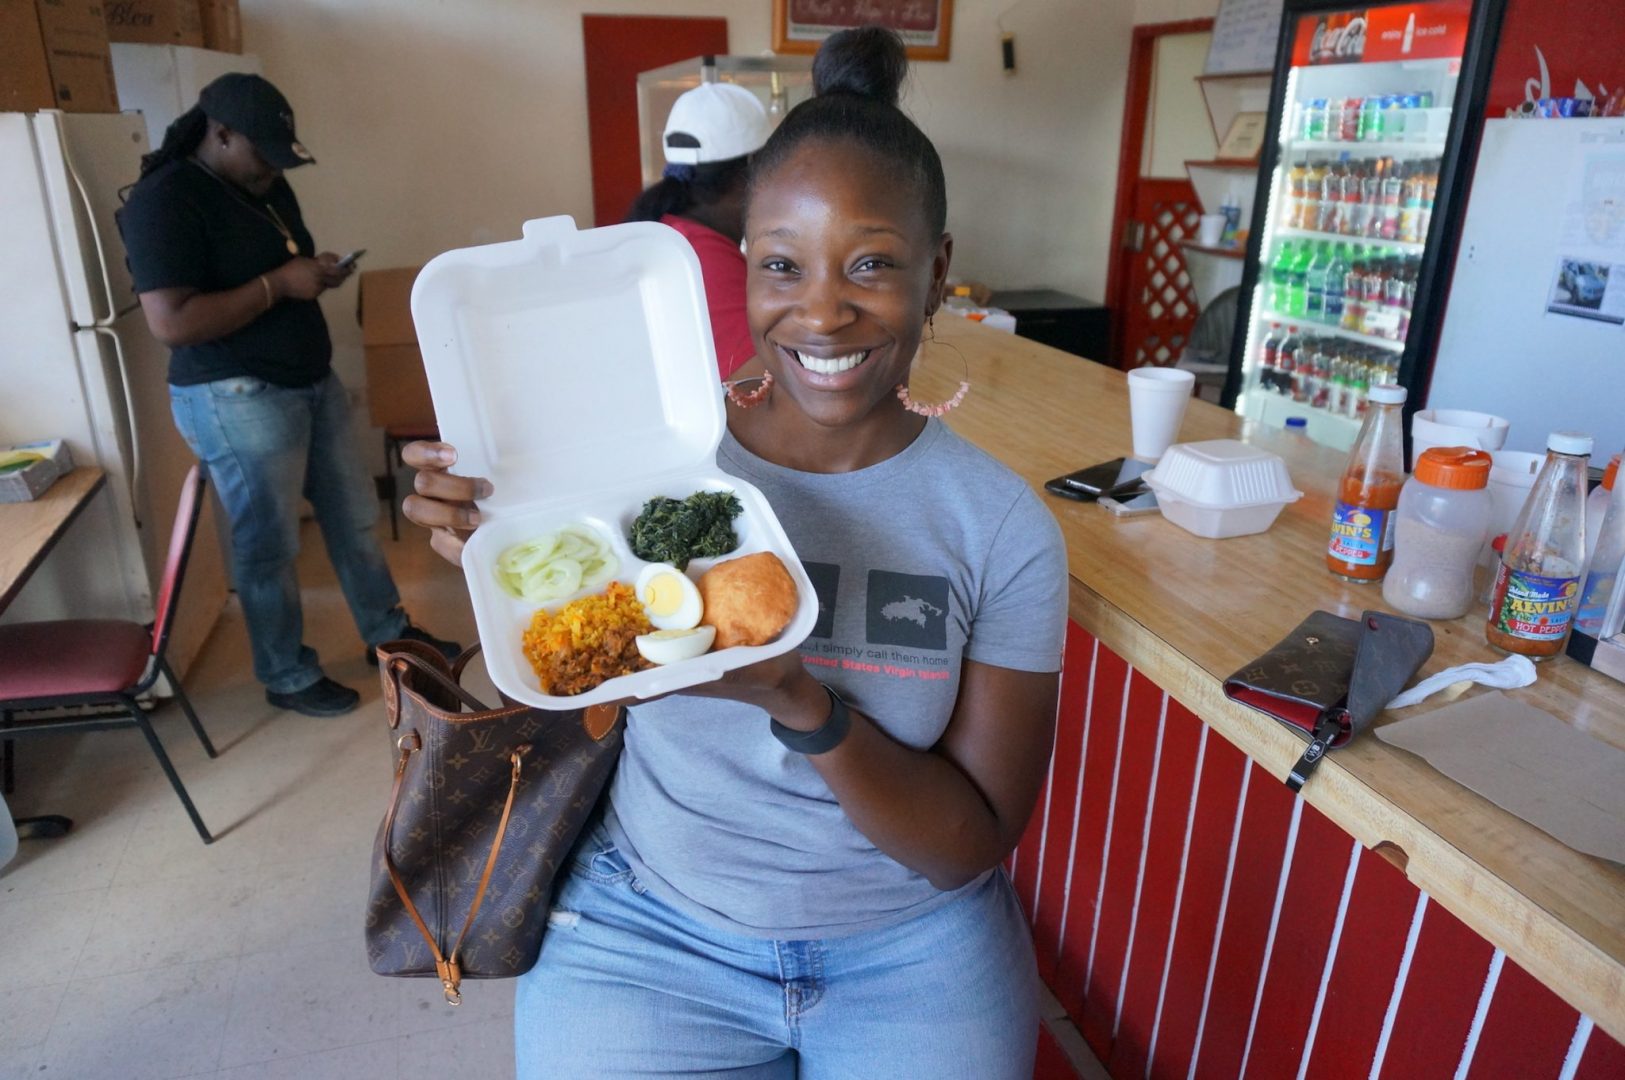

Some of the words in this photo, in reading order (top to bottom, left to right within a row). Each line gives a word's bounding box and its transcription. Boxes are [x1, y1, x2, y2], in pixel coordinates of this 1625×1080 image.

[1516, 621, 1537, 633] HOT
[823, 643, 863, 658] simply
[866, 649, 888, 660] call
[891, 651, 920, 664] them
[922, 655, 949, 666] home
[842, 659, 880, 673] States
[883, 664, 916, 679] Virgin
